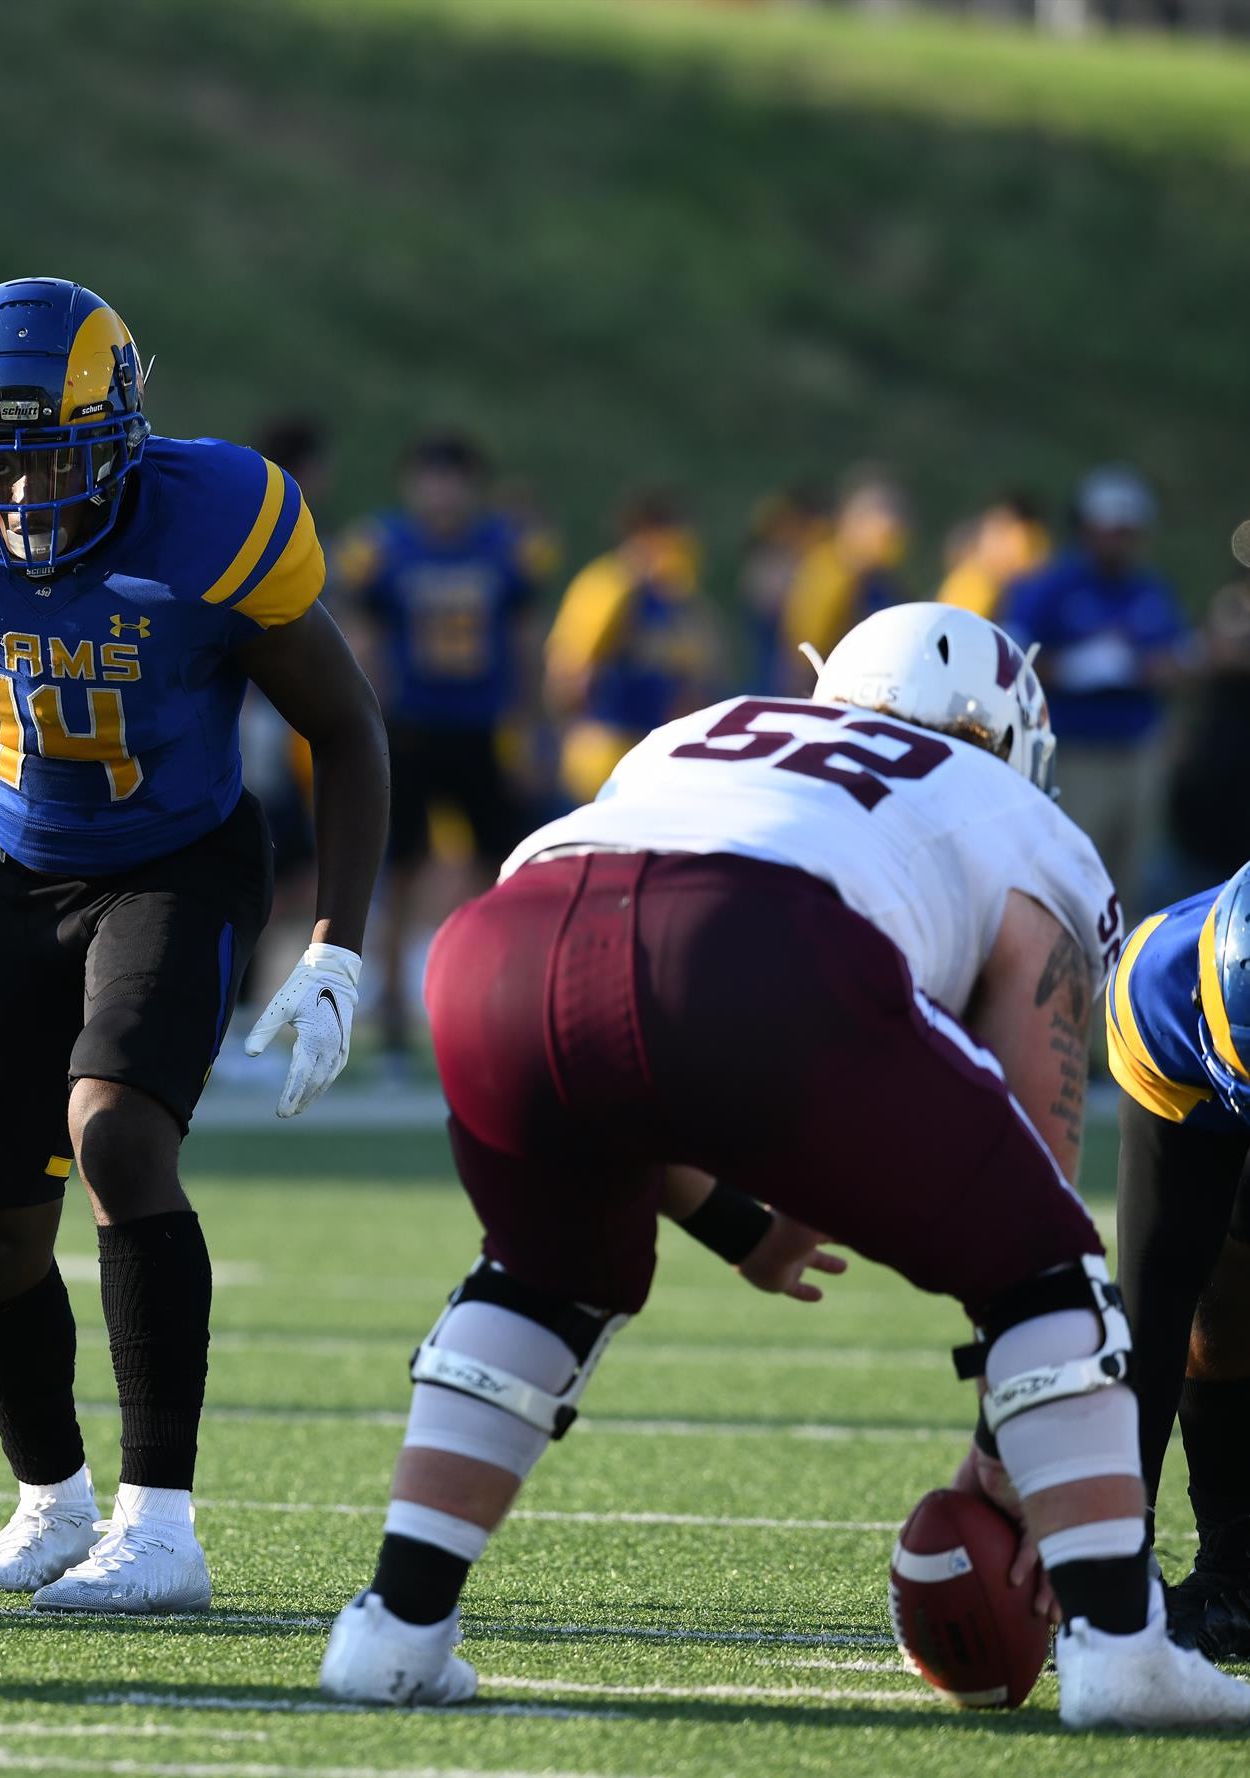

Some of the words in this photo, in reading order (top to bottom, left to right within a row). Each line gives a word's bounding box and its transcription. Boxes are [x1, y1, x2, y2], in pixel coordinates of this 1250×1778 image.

[2, 405, 38, 417] schutt
[82, 404, 103, 415] schutt
[669, 701, 954, 811] 52
